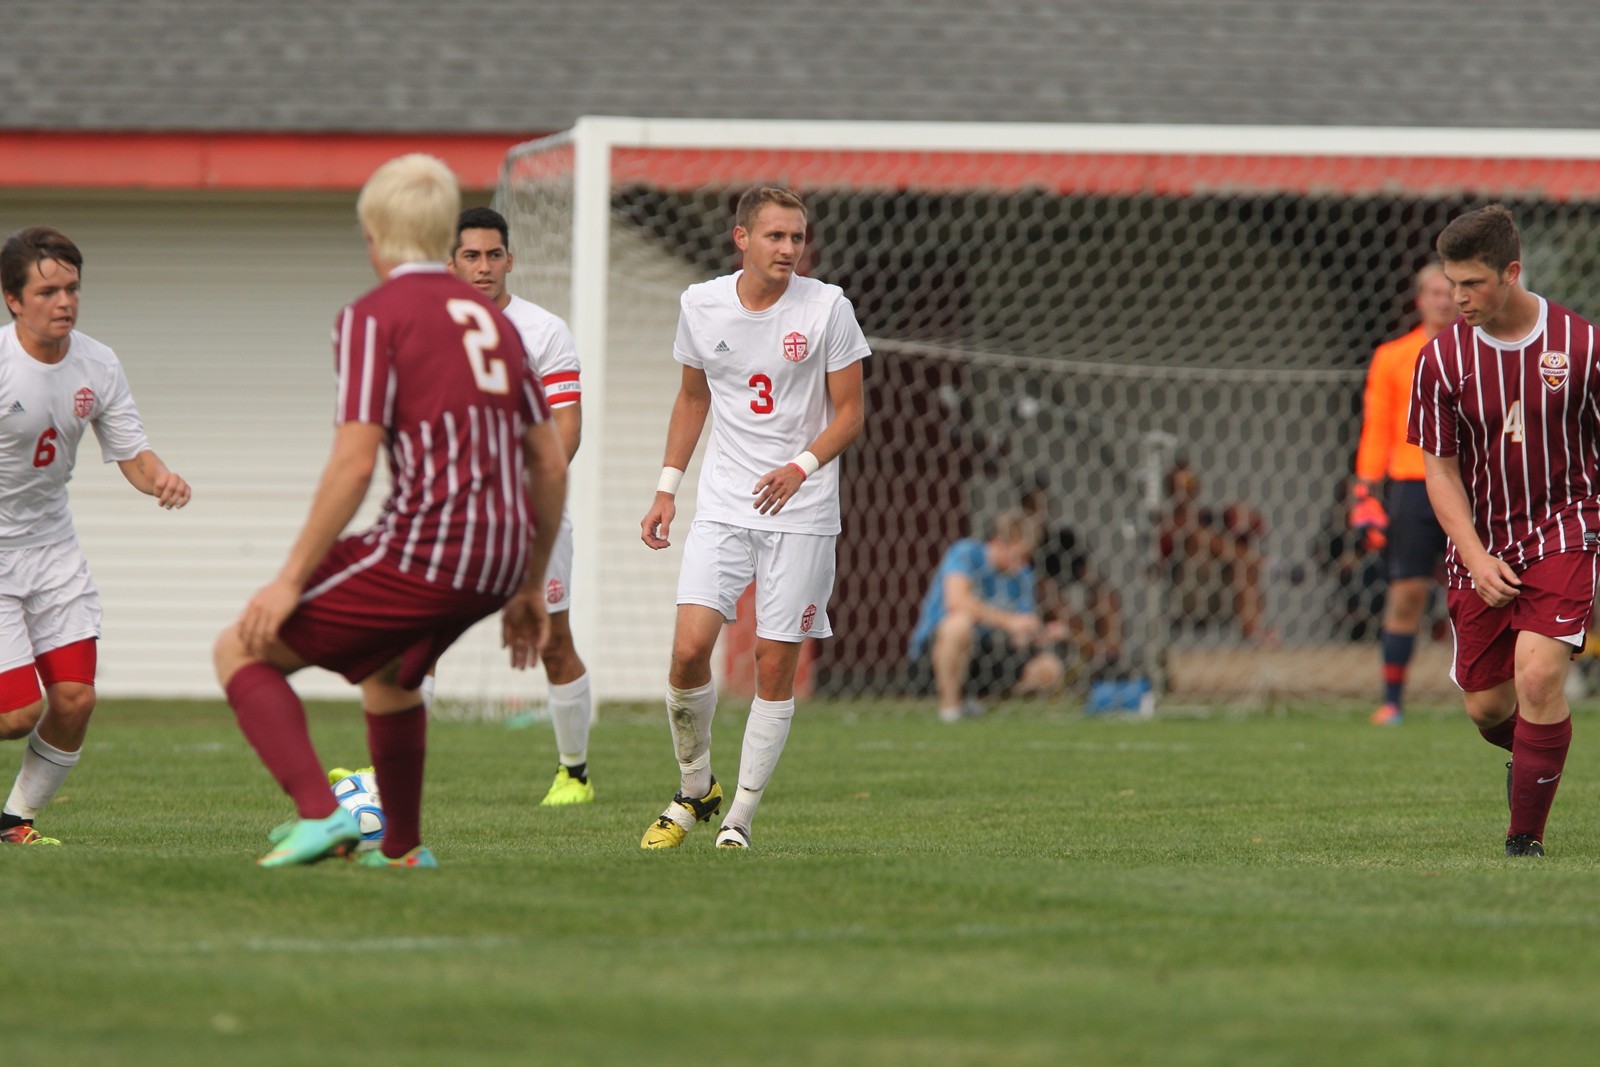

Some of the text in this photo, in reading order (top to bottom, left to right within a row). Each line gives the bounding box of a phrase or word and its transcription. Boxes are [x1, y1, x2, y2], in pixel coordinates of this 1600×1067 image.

[446, 298, 510, 394] 2
[748, 373, 774, 415] 3
[1503, 399, 1523, 443] 4
[32, 426, 58, 469] 6
